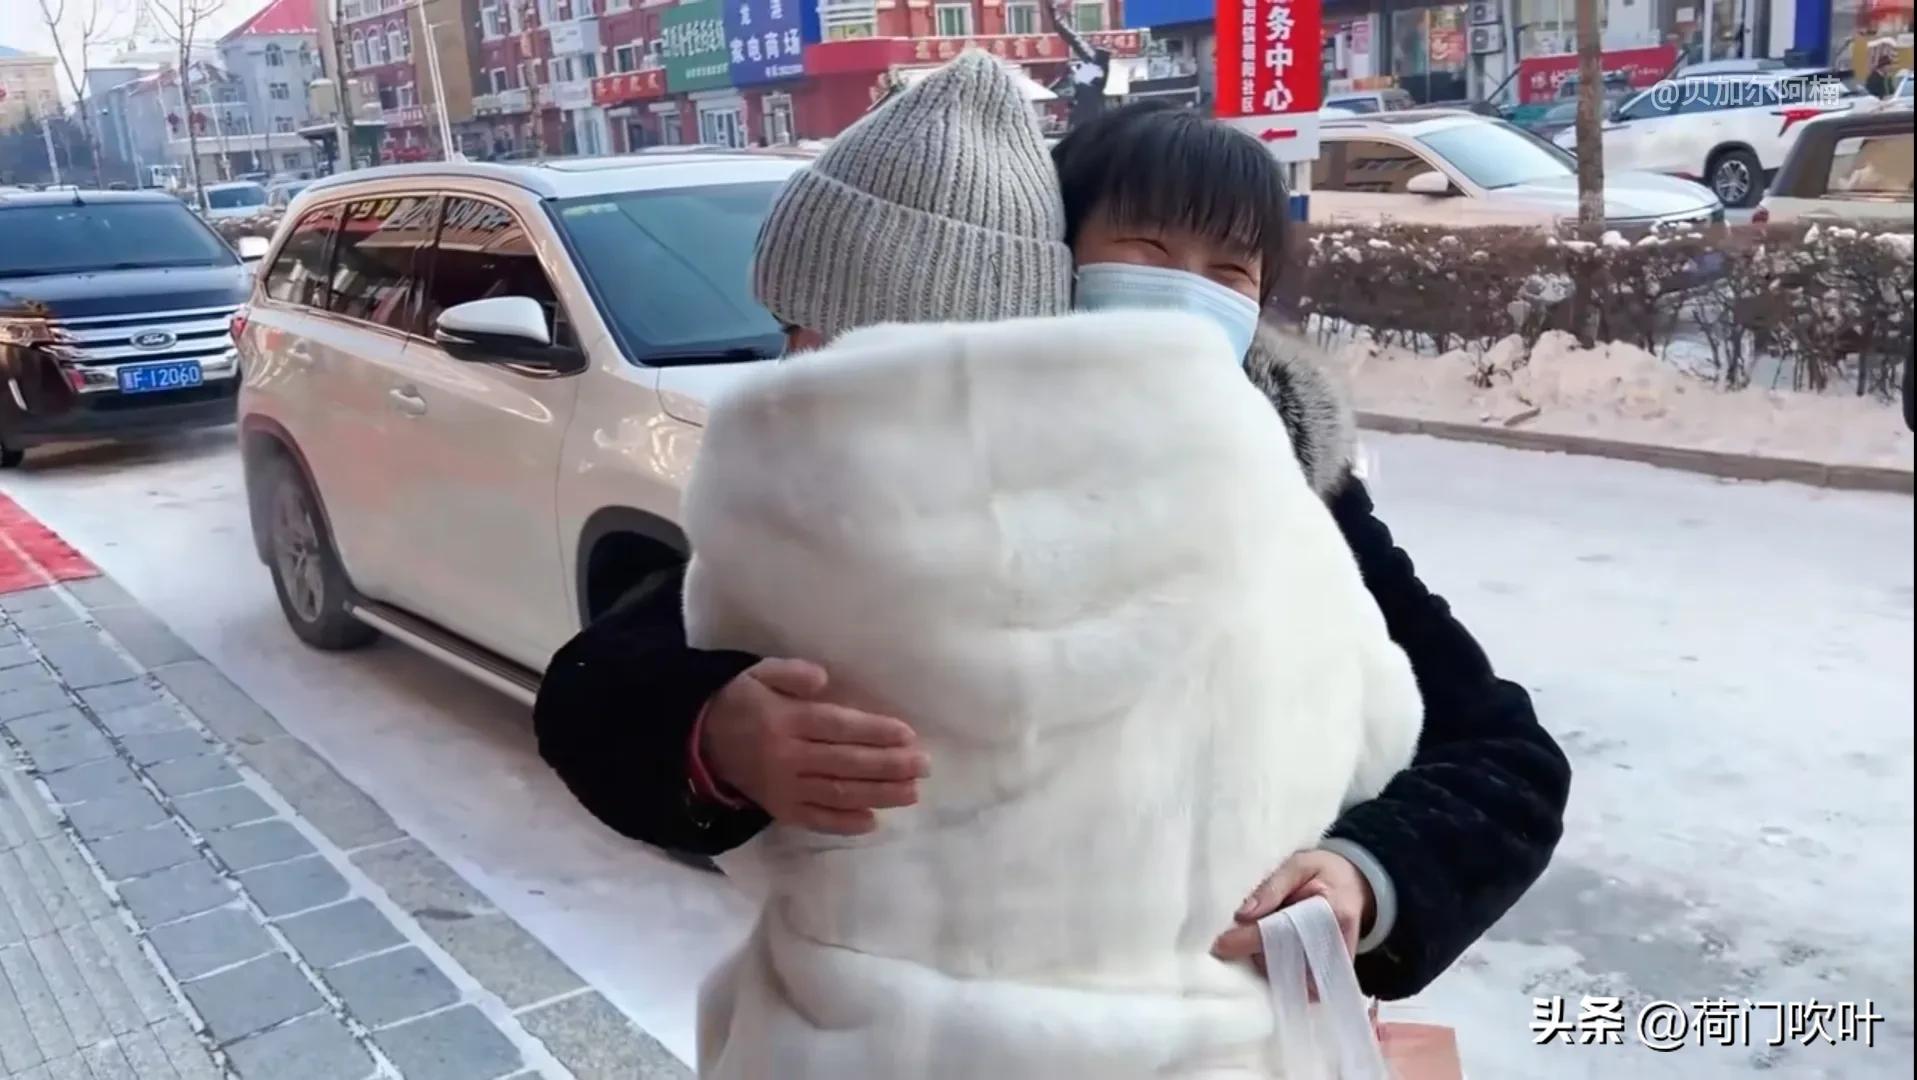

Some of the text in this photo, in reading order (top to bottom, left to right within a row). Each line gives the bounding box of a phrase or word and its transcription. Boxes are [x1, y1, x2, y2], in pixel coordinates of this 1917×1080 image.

[729, 28, 801, 64] 家电商场
[1264, 0, 1296, 112] 务中心
[141, 333, 166, 345] Ford
